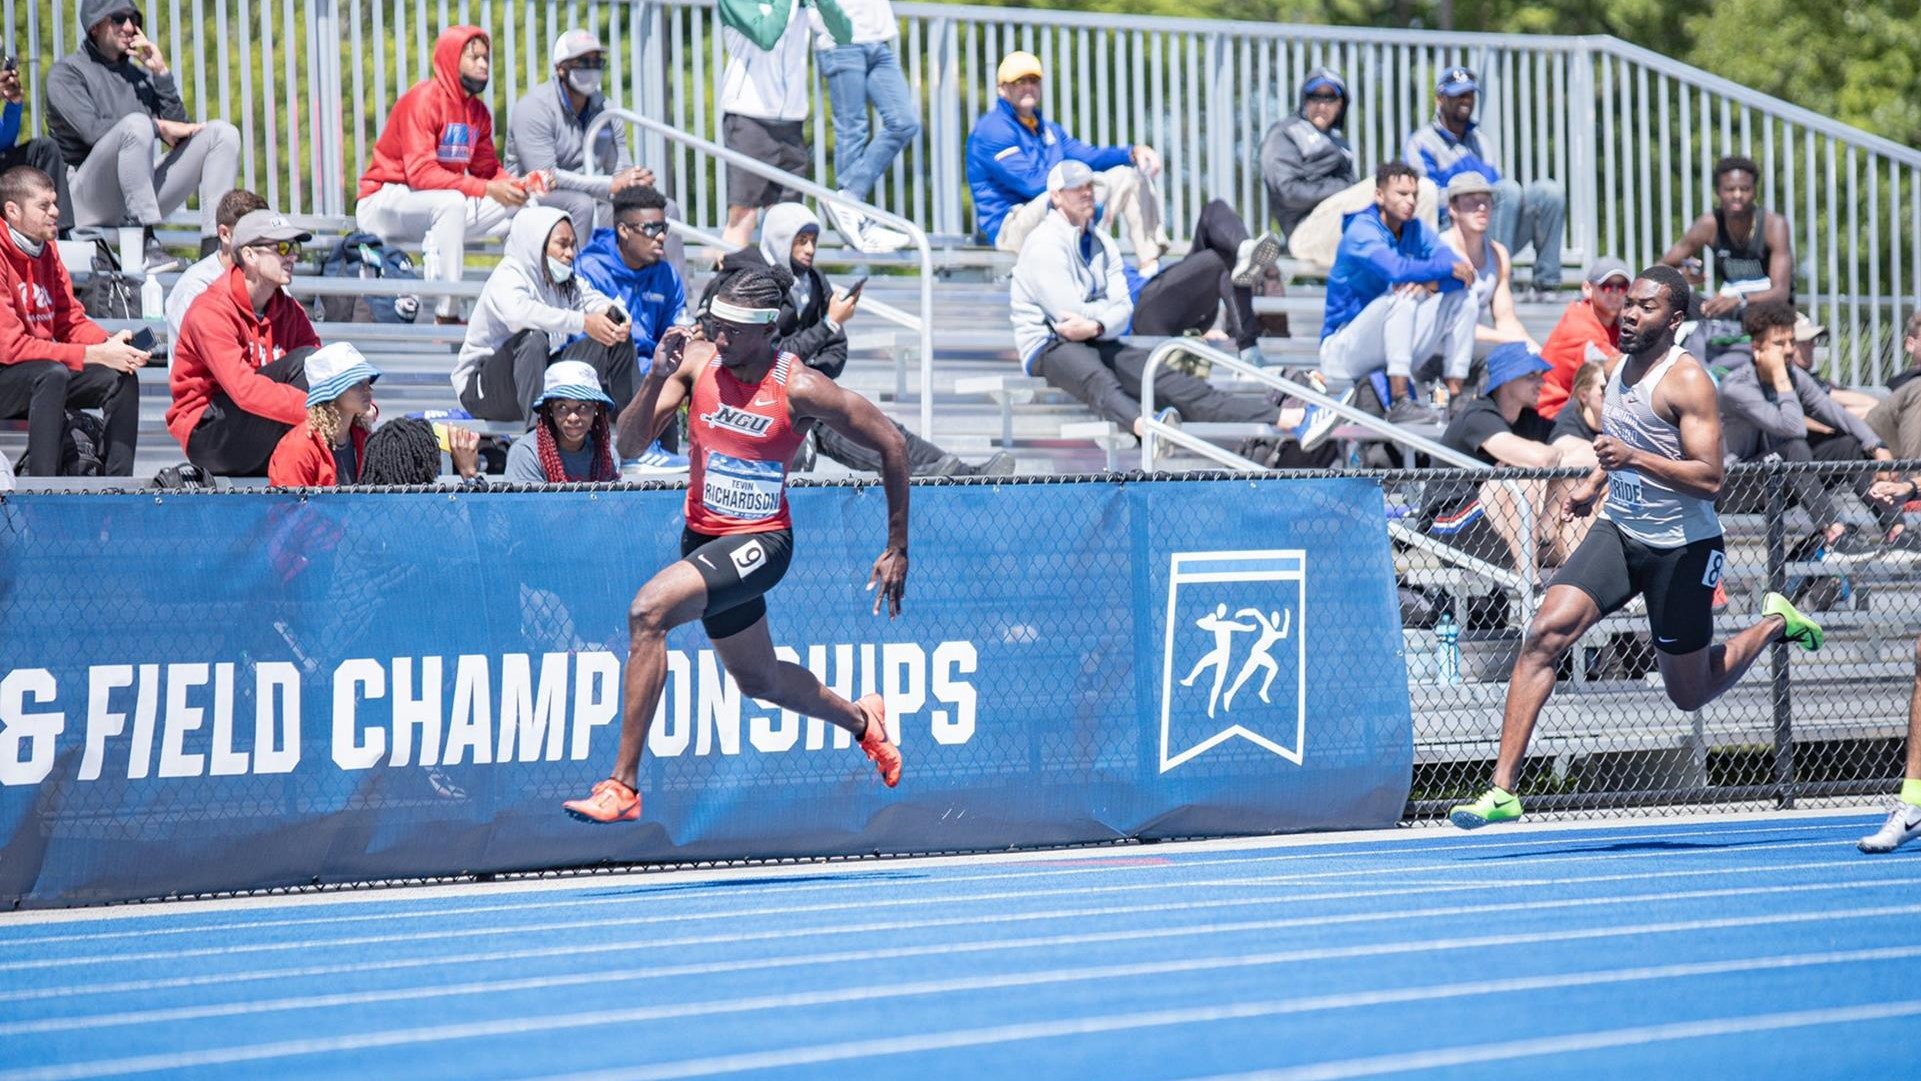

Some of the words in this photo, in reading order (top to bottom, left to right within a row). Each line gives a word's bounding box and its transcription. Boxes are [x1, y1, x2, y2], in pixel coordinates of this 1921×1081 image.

[715, 407, 770, 431] NGU
[705, 483, 779, 511] RICHARDSON
[732, 480, 754, 491] TEVIN
[1611, 479, 1641, 503] RIDE
[736, 546, 762, 569] 9
[1708, 554, 1723, 585] 8
[0, 668, 65, 786] &
[77, 662, 301, 780] FIELD
[331, 641, 978, 771] CHAMPONSHIPS
